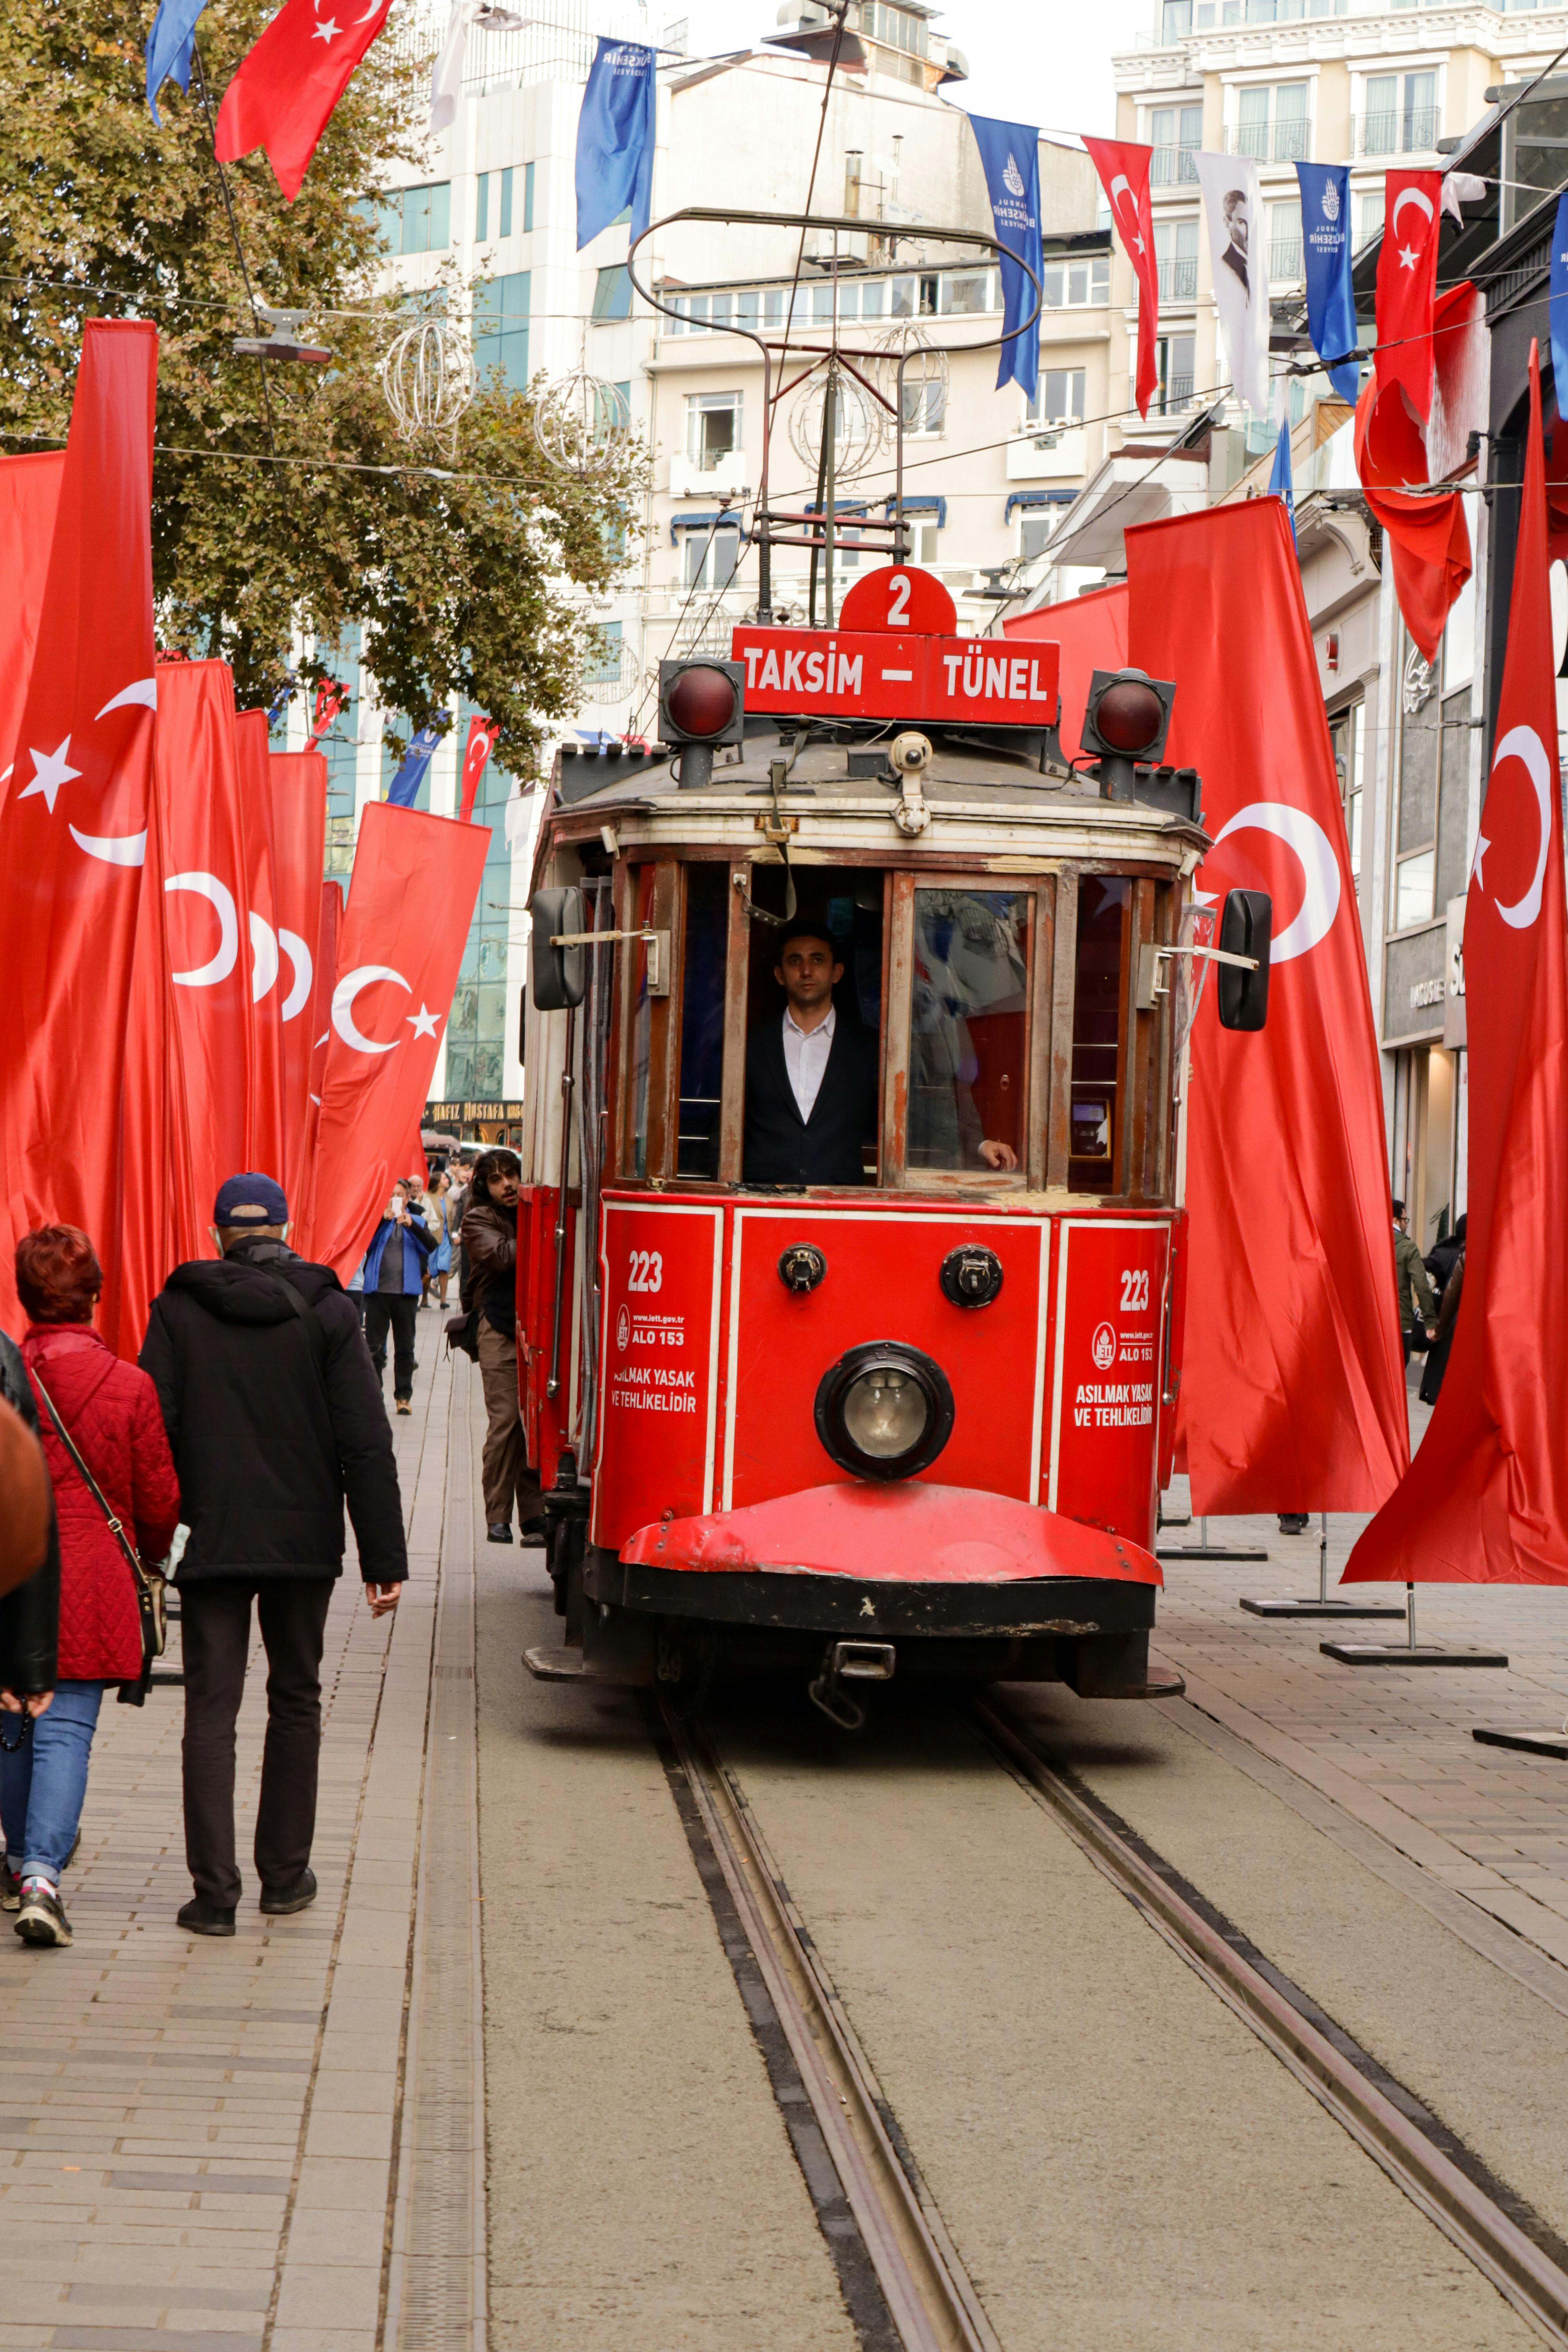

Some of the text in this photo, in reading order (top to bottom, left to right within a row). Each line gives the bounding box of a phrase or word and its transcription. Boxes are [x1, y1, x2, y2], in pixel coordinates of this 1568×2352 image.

[887, 574, 911, 626] 2
[743, 641, 863, 695] TAKSİM
[943, 645, 1047, 701] TÜNEL
[432, 1103, 460, 1122] HAFIZ
[464, 1102, 504, 1122] MUSTAFA
[628, 1250, 662, 1293] 223
[1120, 1270, 1149, 1311] 223
[633, 1314, 684, 1324] www.iett.gov.tr
[632, 1330, 684, 1346] ALO 153
[1119, 1348, 1152, 1361] ALO 153
[653, 1368, 695, 1388] YASAK
[612, 1390, 696, 1413] VE TEHLİKELİDİR
[1076, 1384, 1152, 1403] ASILMAK YASAK
[1074, 1403, 1152, 1426] VE TEHLİKELİDİR
